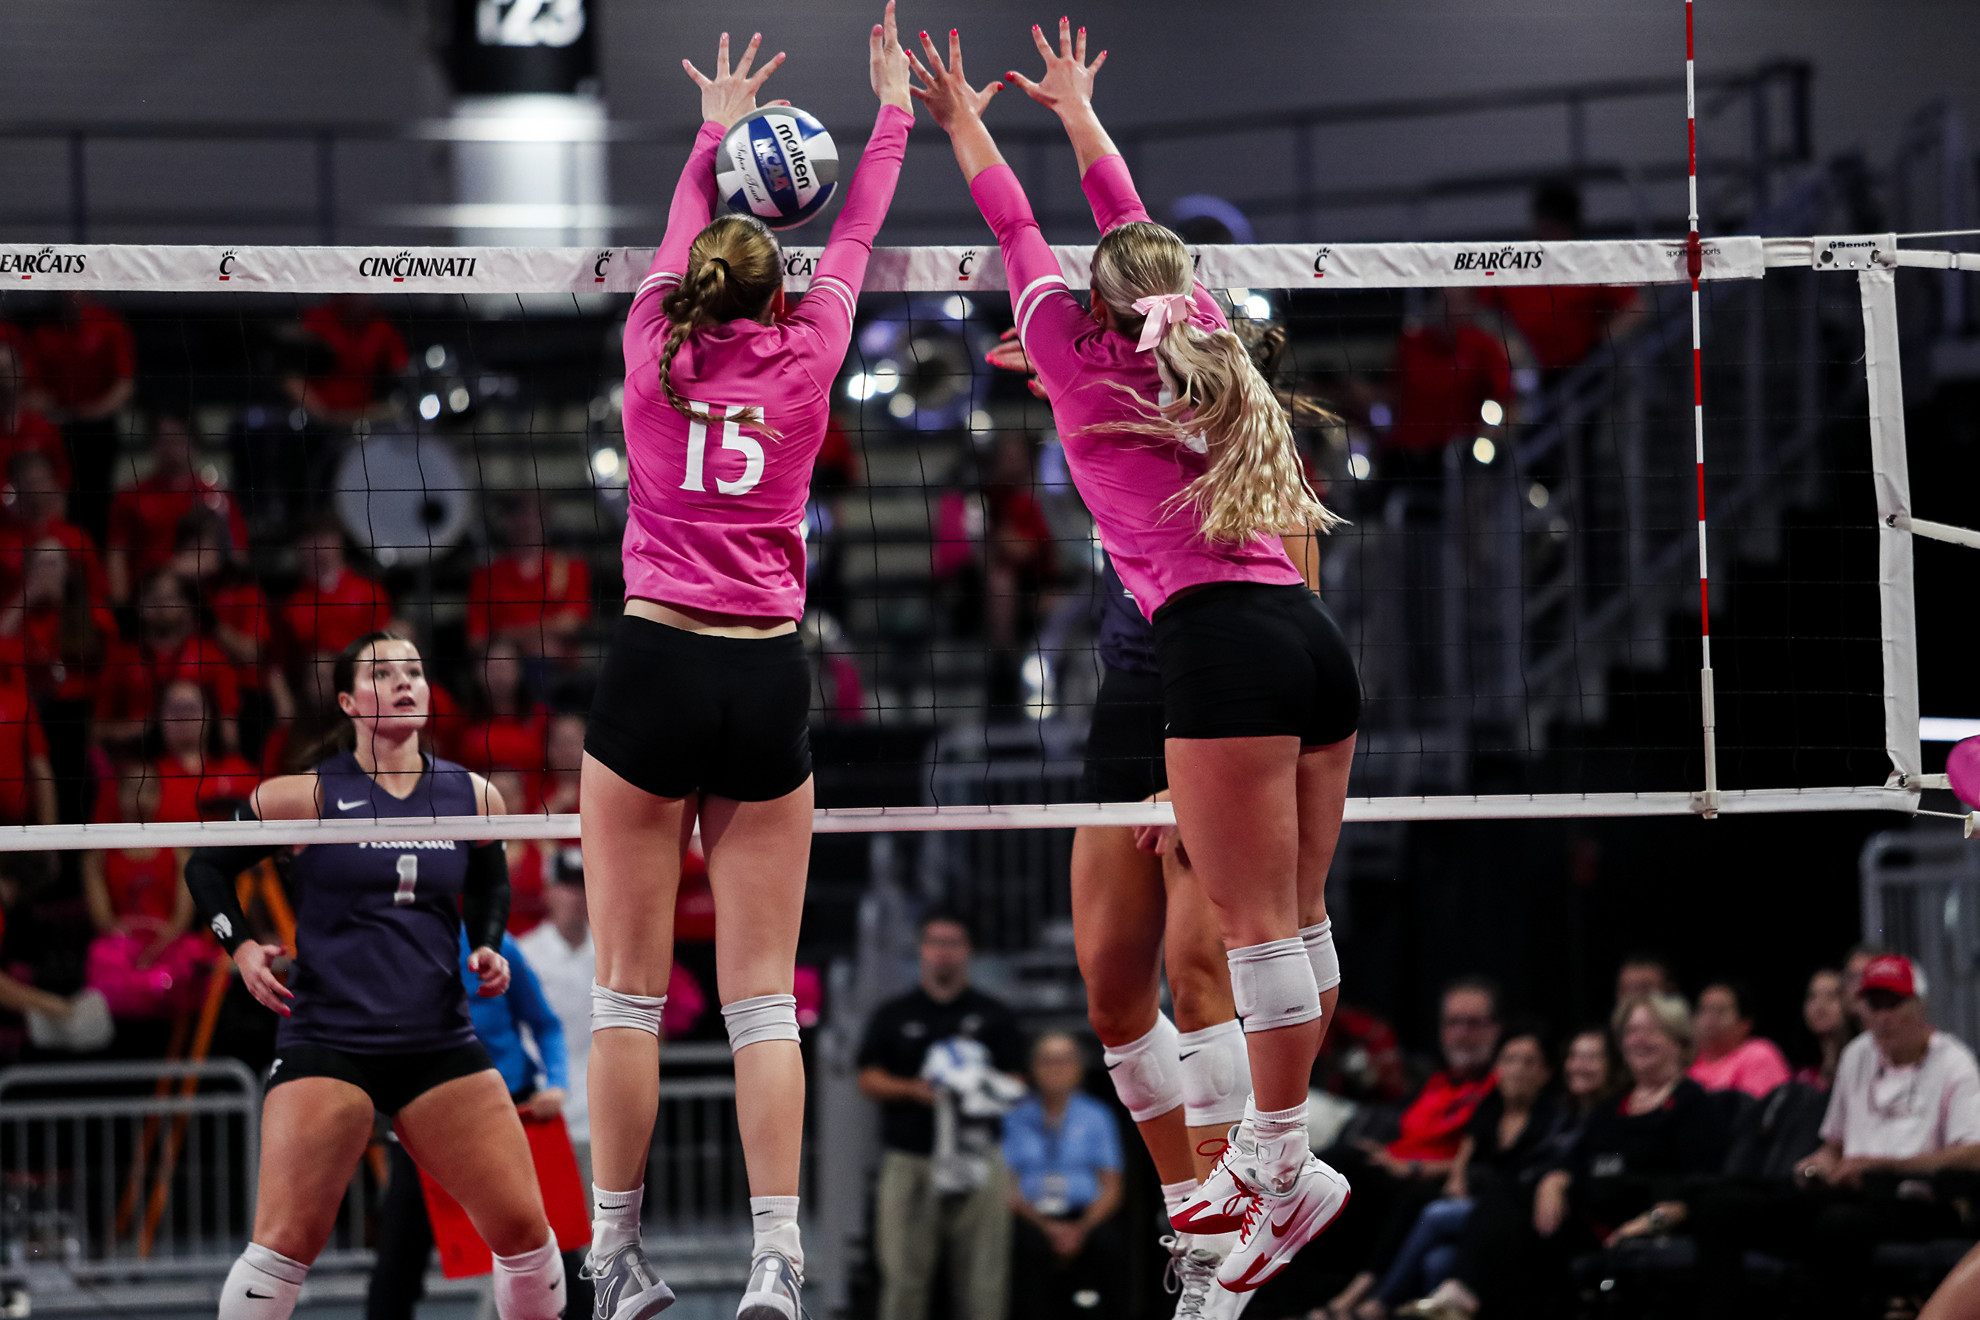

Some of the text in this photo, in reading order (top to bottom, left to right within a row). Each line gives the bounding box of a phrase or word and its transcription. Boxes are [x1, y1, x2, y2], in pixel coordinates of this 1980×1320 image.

[776, 124, 811, 189] molten
[743, 173, 766, 203] Touch
[0, 248, 87, 273] EARCATS
[359, 251, 476, 276] CINCINNATI
[1454, 246, 1543, 270] BEARCATS
[679, 400, 765, 496] 15
[394, 854, 418, 906] 1
